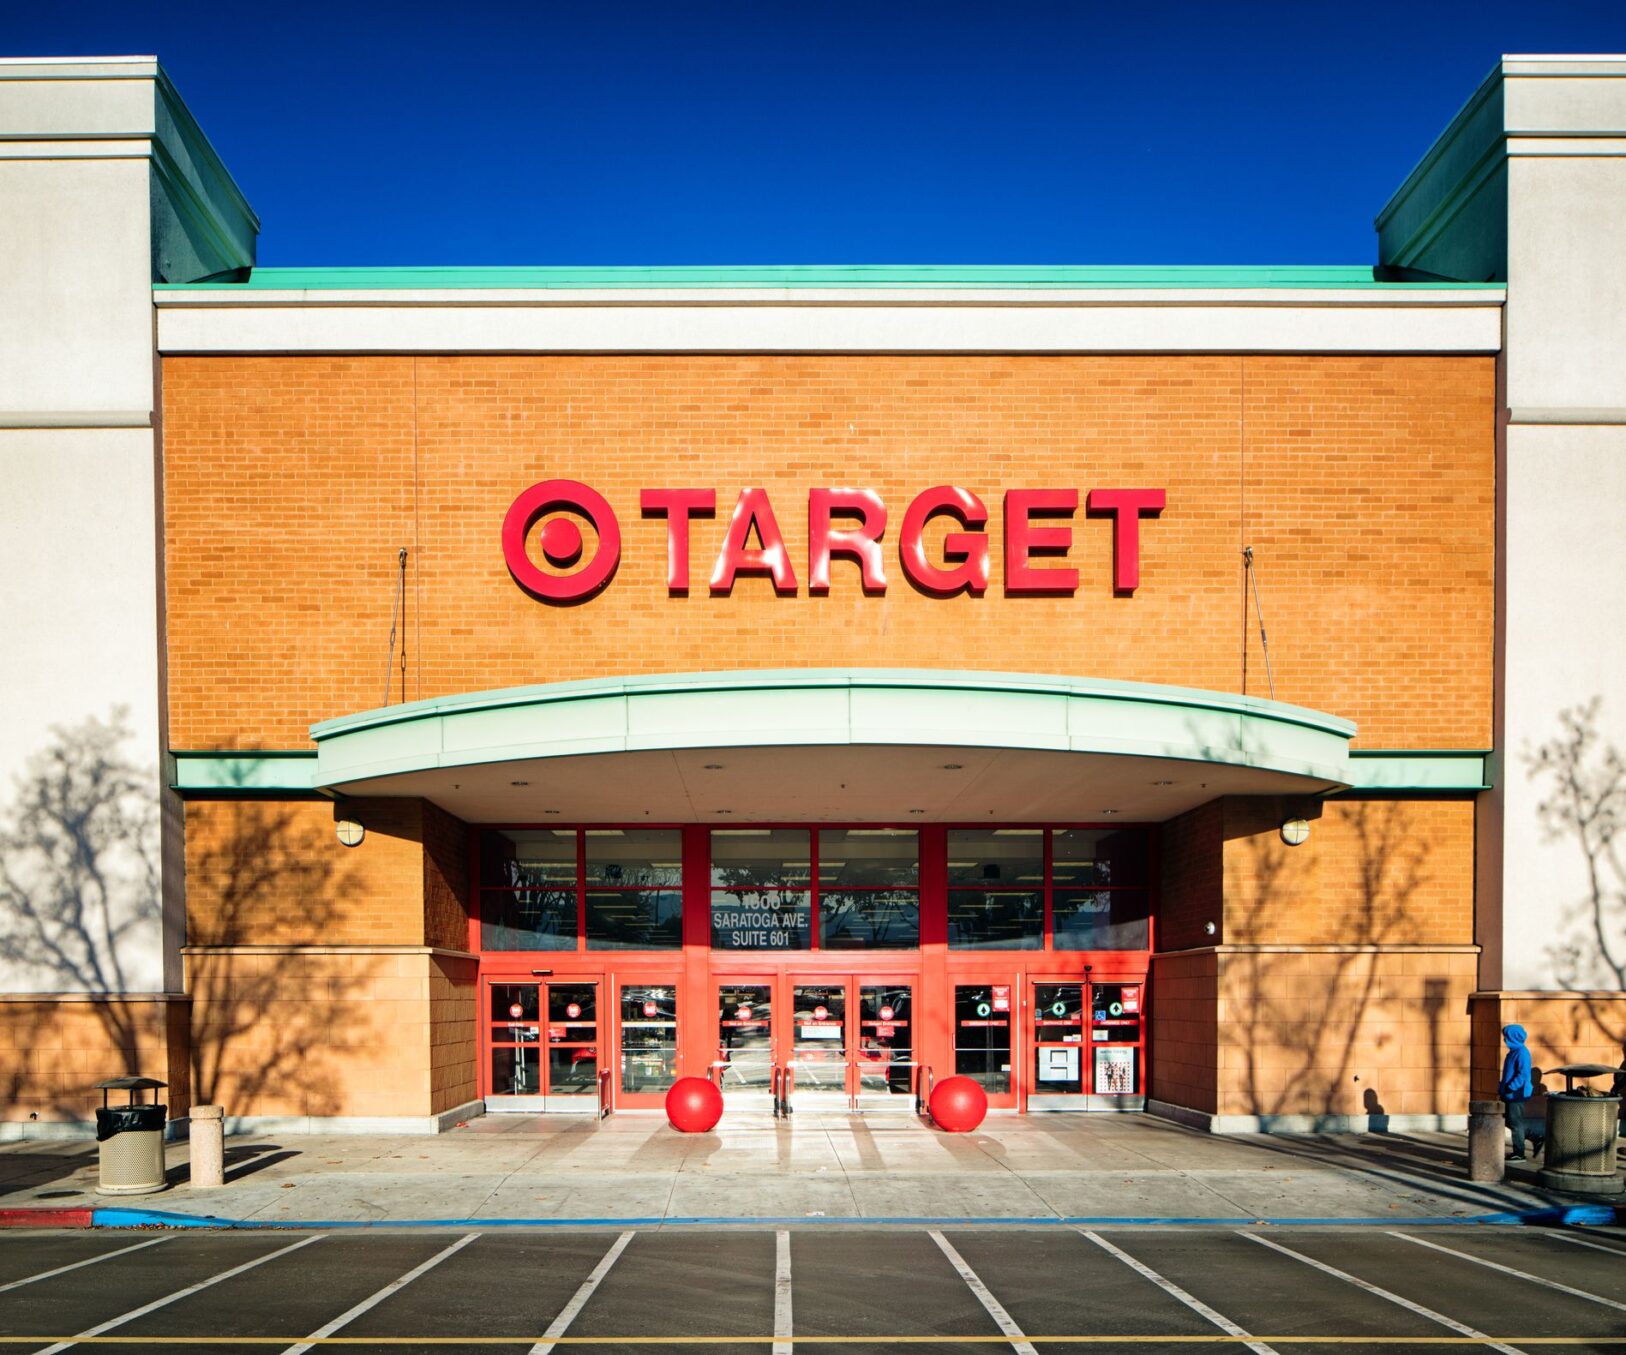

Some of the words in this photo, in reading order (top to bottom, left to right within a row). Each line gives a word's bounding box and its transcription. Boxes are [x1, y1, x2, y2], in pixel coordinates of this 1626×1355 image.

[640, 485, 1166, 597] TARGET
[714, 913, 779, 928] SARATOGA
[782, 913, 808, 928] AVE.
[732, 931, 767, 946] SUITE
[770, 931, 789, 946] 601
